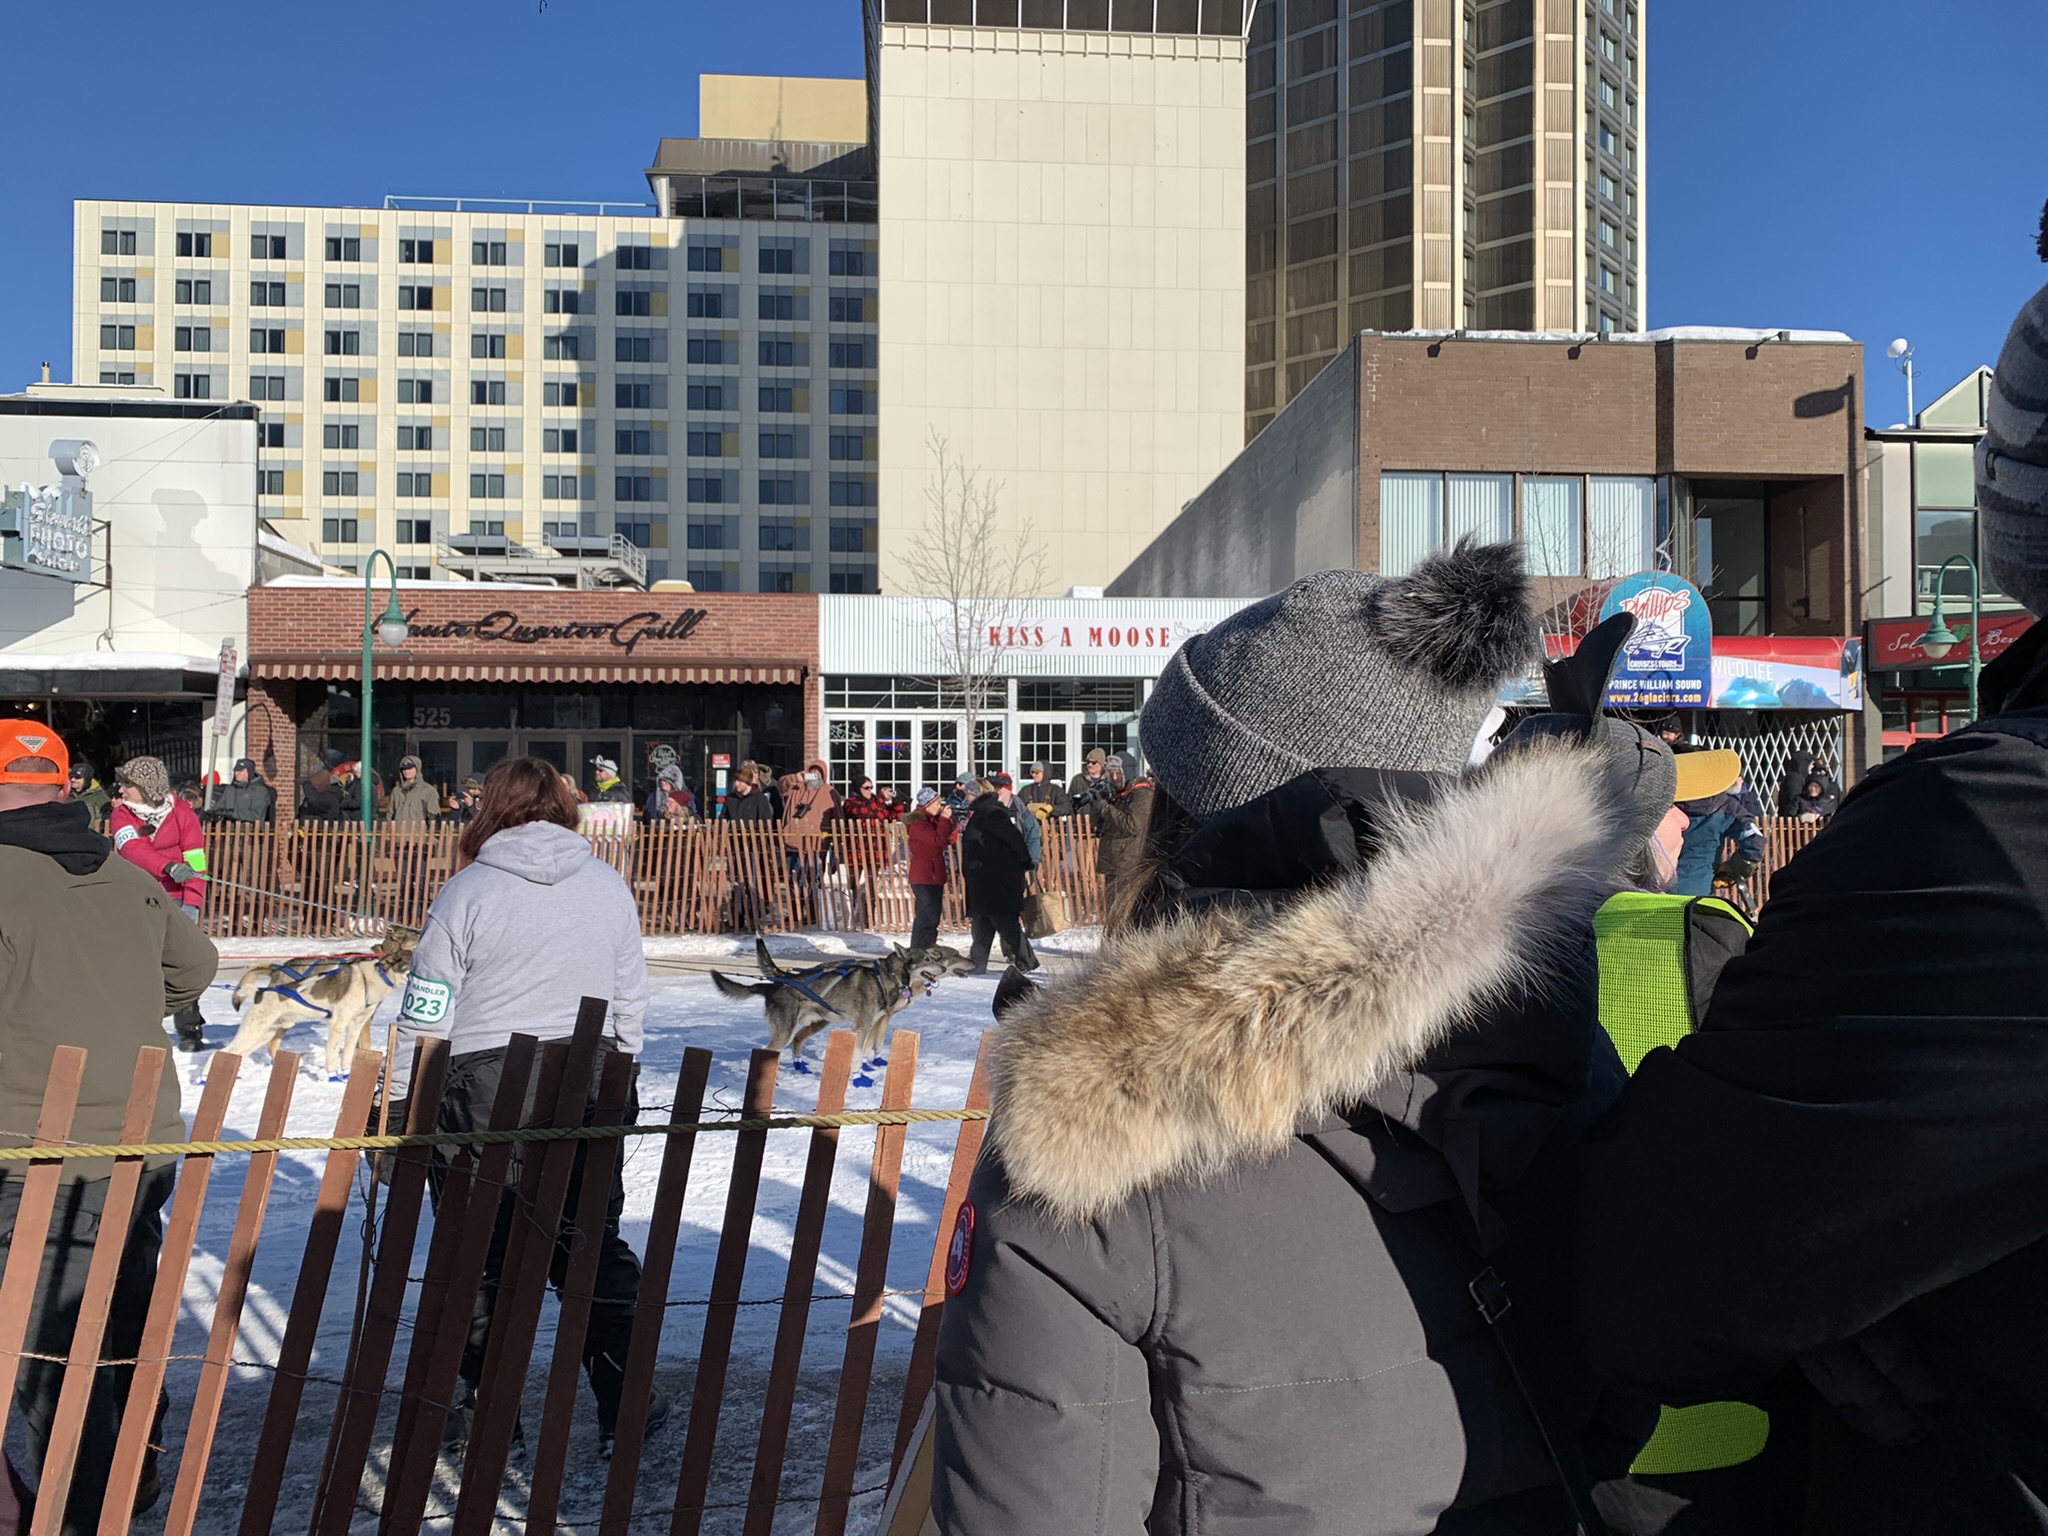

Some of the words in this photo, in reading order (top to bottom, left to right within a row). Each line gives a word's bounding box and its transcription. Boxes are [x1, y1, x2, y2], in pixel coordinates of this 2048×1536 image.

[30, 523, 88, 560] PHOTO
[475, 610, 616, 643] Quarter
[609, 608, 708, 656] Grill
[988, 626, 1044, 647] KISS
[1060, 626, 1073, 647] A
[1089, 626, 1170, 648] MOOSE
[1711, 655, 1775, 681] WILDLIFE
[1609, 680, 1638, 690] PRINCE
[1640, 680, 1674, 690] WILLIAM
[1675, 680, 1702, 690] SOUND
[1609, 692, 1702, 705] www.26glaciers.com
[413, 707, 451, 727] 525
[405, 992, 442, 1017] 023
